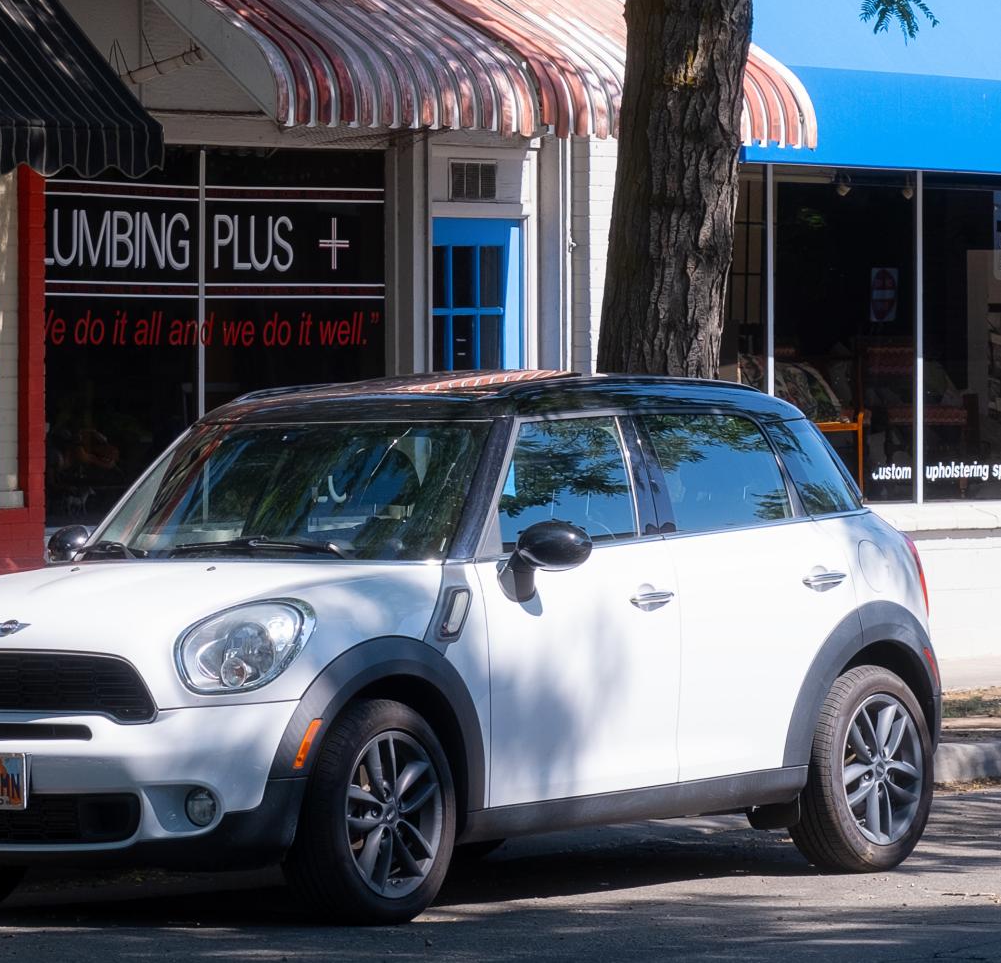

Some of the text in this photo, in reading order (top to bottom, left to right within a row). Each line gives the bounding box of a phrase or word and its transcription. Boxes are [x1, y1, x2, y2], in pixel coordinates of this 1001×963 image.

[213, 214, 295, 272] PLUS
[74, 309, 105, 346] do
[112, 309, 128, 346] it
[134, 310, 164, 346] all
[168, 311, 217, 347] and
[222, 320, 256, 347] we
[263, 311, 292, 347] do
[298, 311, 313, 347] it
[925, 460, 990, 482] upholstering
